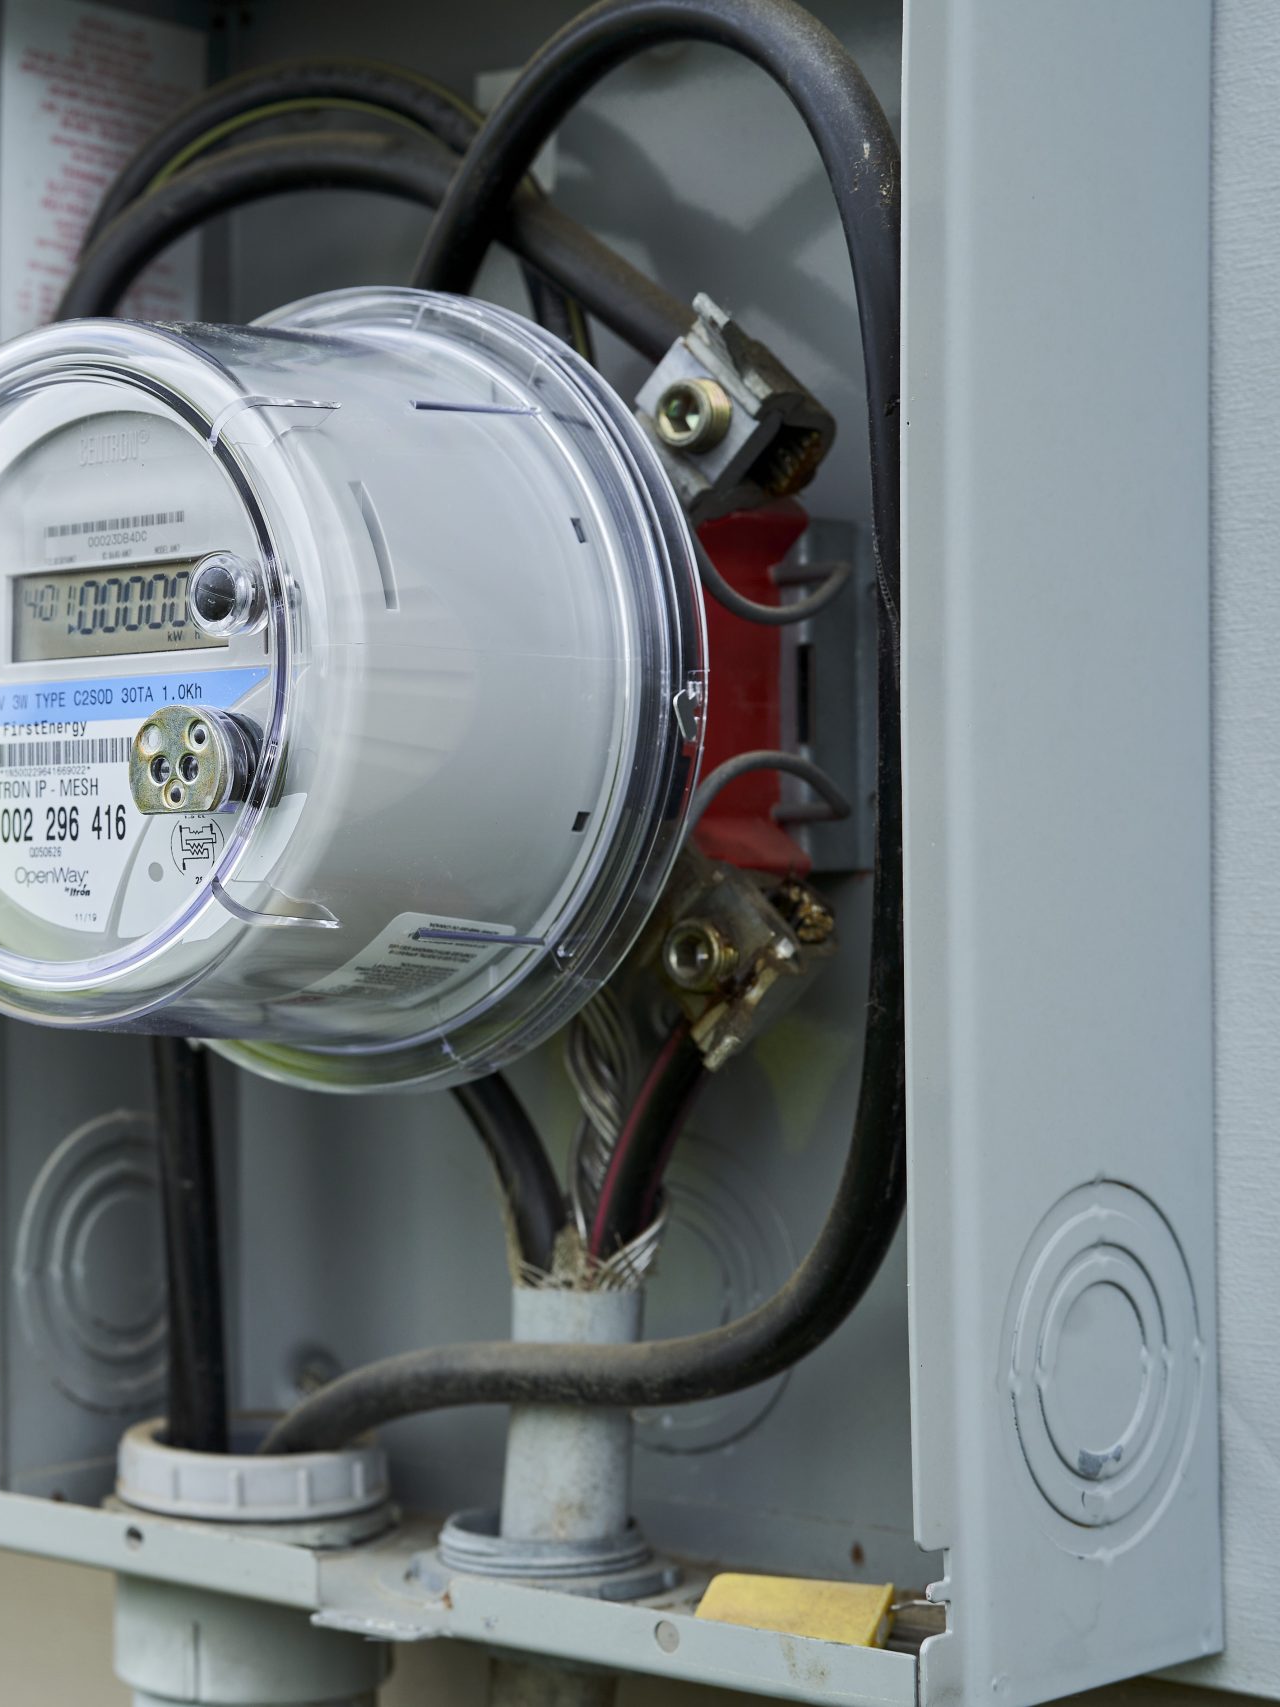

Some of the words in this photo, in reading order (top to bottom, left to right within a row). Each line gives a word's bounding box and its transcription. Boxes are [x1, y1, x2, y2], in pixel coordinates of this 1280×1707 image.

[35, 692, 66, 708] TYPE
[121, 686, 154, 703] 30TA
[162, 683, 202, 701] 1.0Kh
[3, 720, 87, 737] FirstEnergy
[35, 779, 47, 798] IP
[60, 777, 98, 797] MESH
[1, 807, 33, 843] 002
[46, 806, 79, 842] 296
[91, 804, 126, 840] 416
